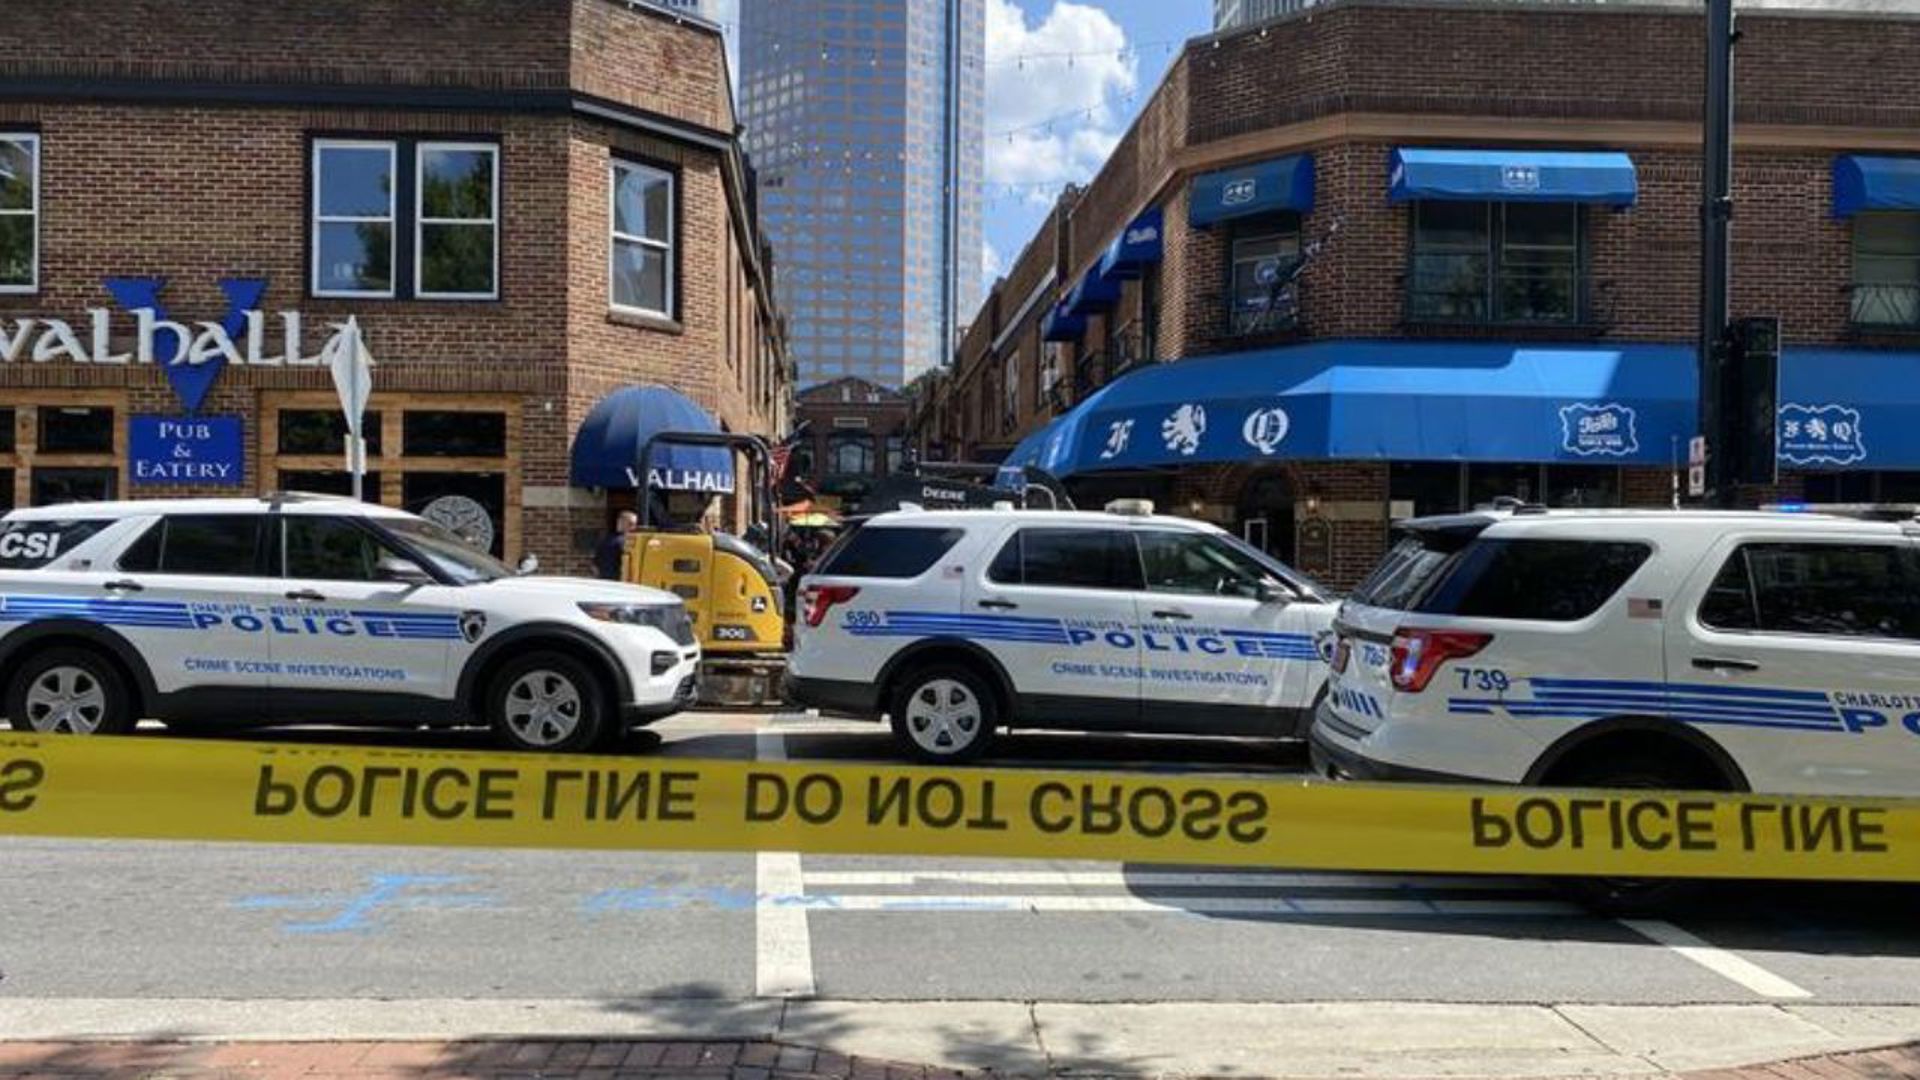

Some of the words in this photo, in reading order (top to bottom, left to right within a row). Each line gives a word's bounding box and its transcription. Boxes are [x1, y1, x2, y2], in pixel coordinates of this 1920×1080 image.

[158, 422, 211, 440] PUB
[1242, 407, 1290, 456] Q
[174, 443, 191, 458] &
[136, 460, 232, 478] EATERY
[922, 486, 966, 501] DEERE
[0, 531, 61, 559] CSI
[193, 613, 395, 637] POLICE
[1068, 628, 1264, 657] POLICE
[184, 659, 230, 672] CRIME
[234, 660, 282, 674] SCENE
[286, 664, 406, 680] INVESTIGATIONS
[1052, 662, 1096, 676] CRIME
[1102, 664, 1149, 679] SCENE
[1151, 668, 1268, 687] INVESTIGATIONS
[1454, 666, 1510, 692] 739
